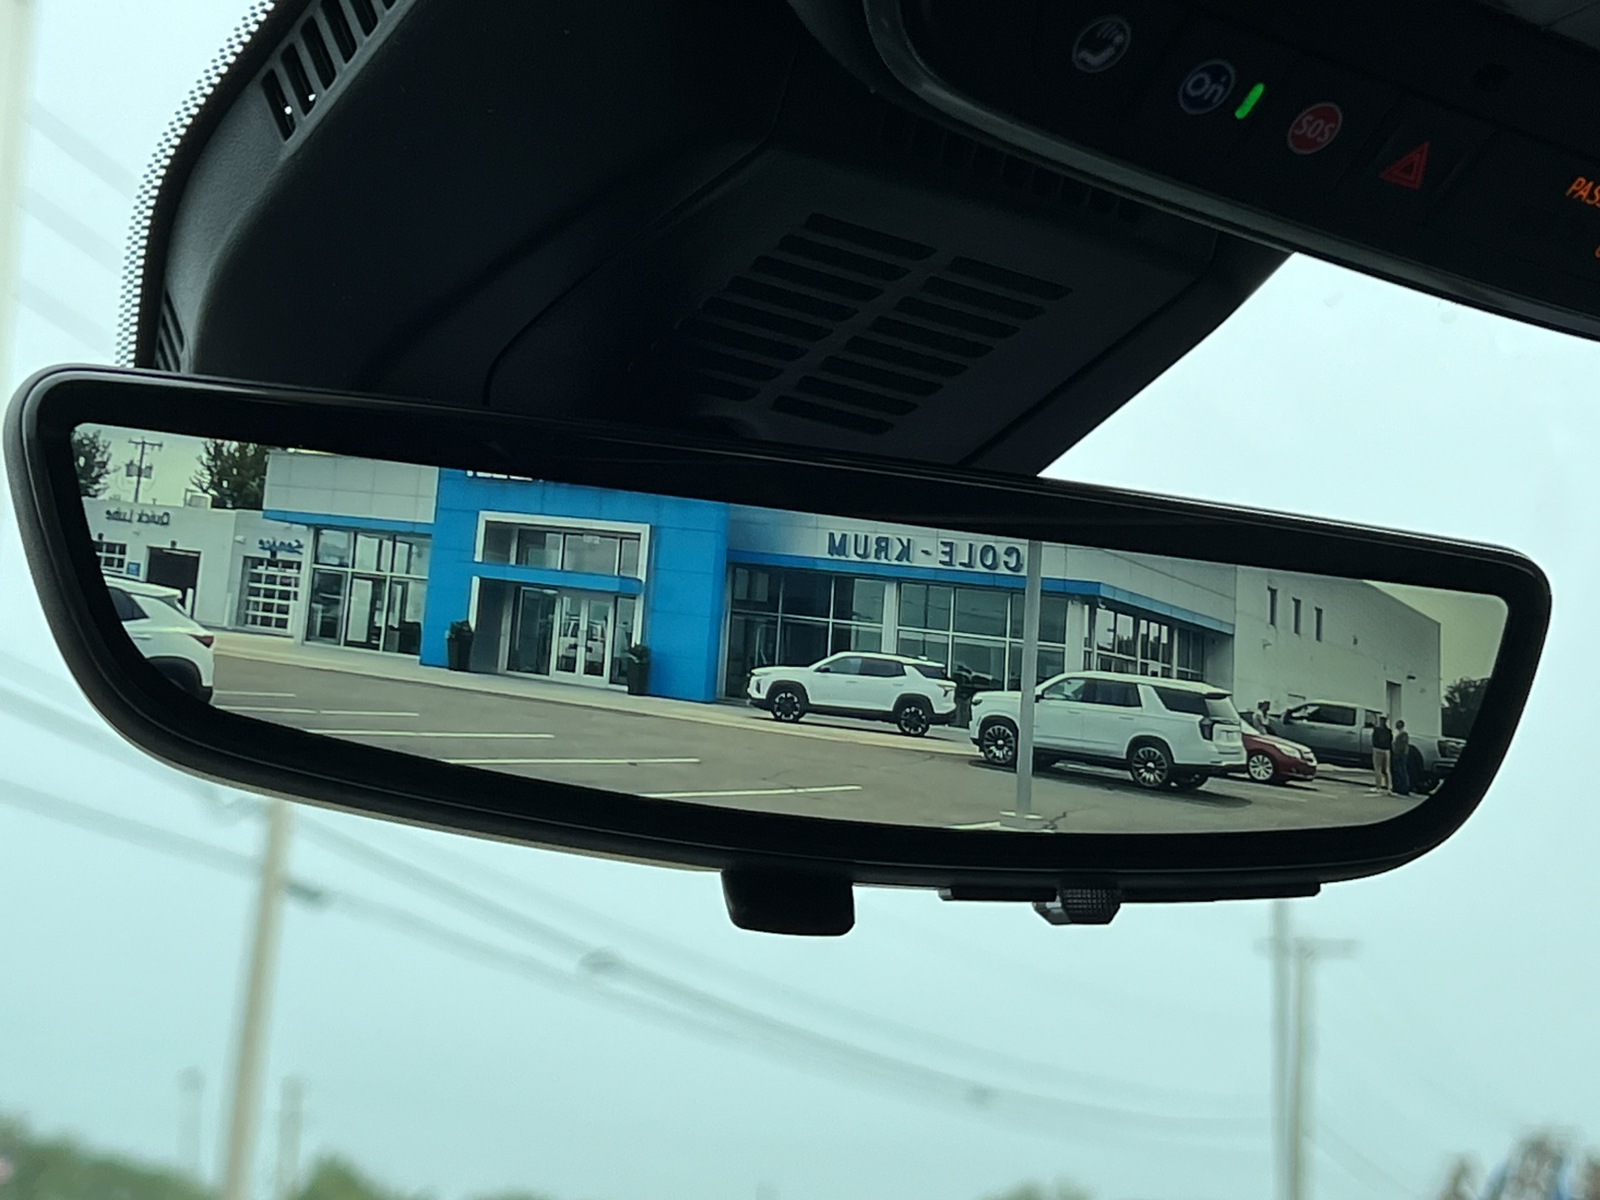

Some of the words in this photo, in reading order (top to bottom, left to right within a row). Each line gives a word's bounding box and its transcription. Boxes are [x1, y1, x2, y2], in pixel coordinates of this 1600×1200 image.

[1187, 72, 1227, 103] On
[1294, 115, 1334, 143] SOS
[1565, 177, 1600, 208] PAS
